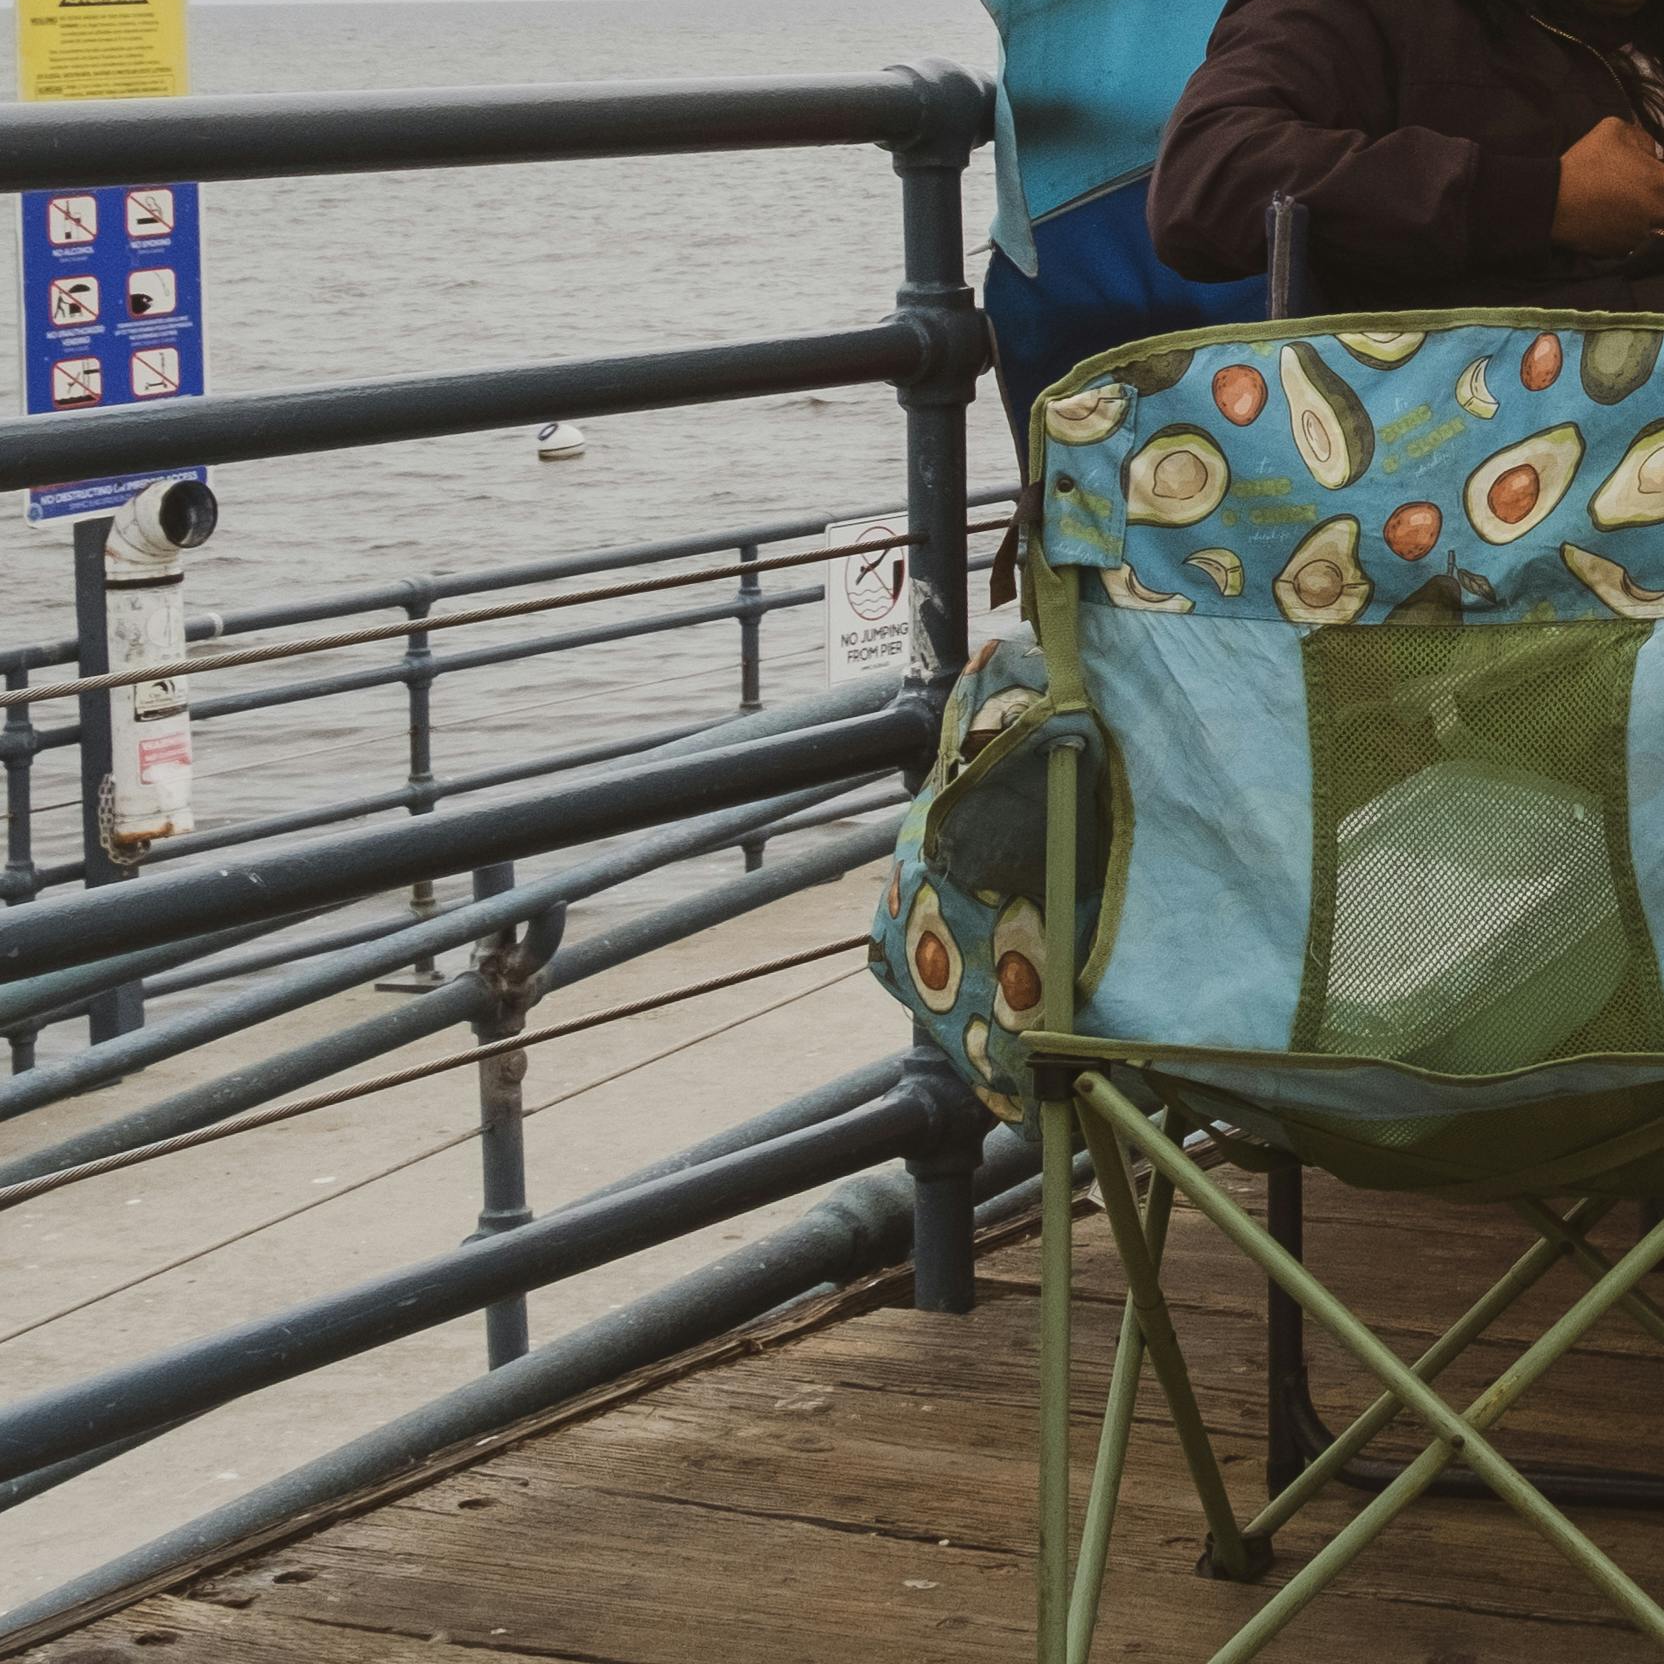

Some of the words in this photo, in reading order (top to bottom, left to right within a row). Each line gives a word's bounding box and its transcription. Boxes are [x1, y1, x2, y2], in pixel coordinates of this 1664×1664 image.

[841, 632, 858, 647] NO
[861, 622, 909, 644] JUMPING
[848, 646, 879, 664] FROM
[881, 641, 903, 656] PIER
